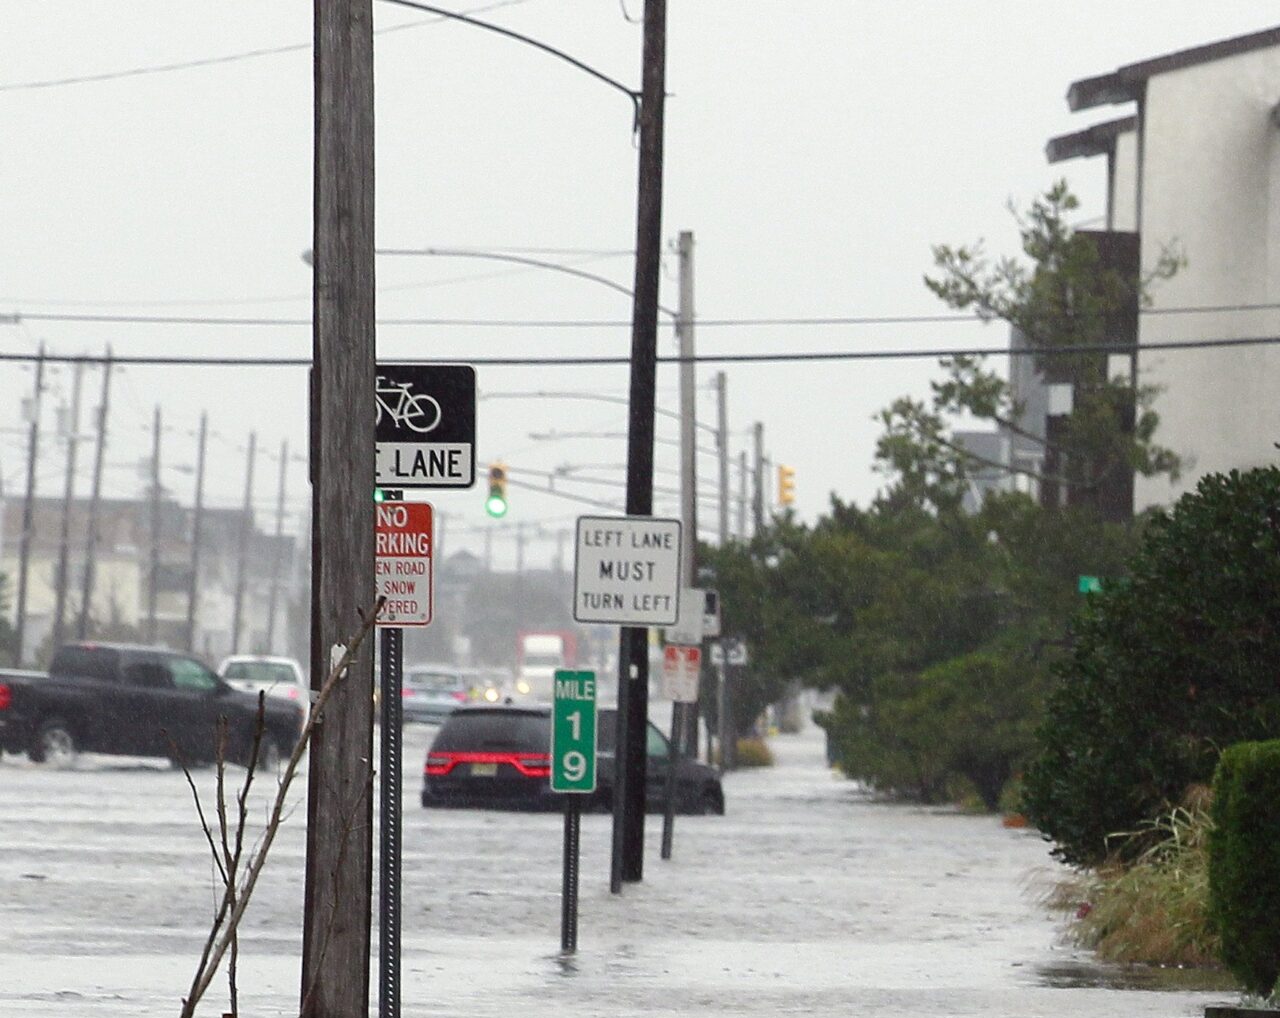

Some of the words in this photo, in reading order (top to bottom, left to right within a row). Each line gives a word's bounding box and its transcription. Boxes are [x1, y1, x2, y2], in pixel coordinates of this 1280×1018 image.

[395, 449, 463, 478] LANE
[375, 505, 408, 528] NO
[375, 532, 429, 555] RKING
[584, 530, 622, 547] LEFT
[631, 532, 672, 549] LANE
[375, 561, 391, 575] EN
[395, 561, 426, 576] ROAD
[599, 560, 655, 581] MUST
[383, 580, 416, 595] SNOW
[381, 600, 418, 615] VERED
[583, 592, 624, 609] TURN
[633, 594, 670, 611] LEFT
[556, 681, 595, 701] MILE
